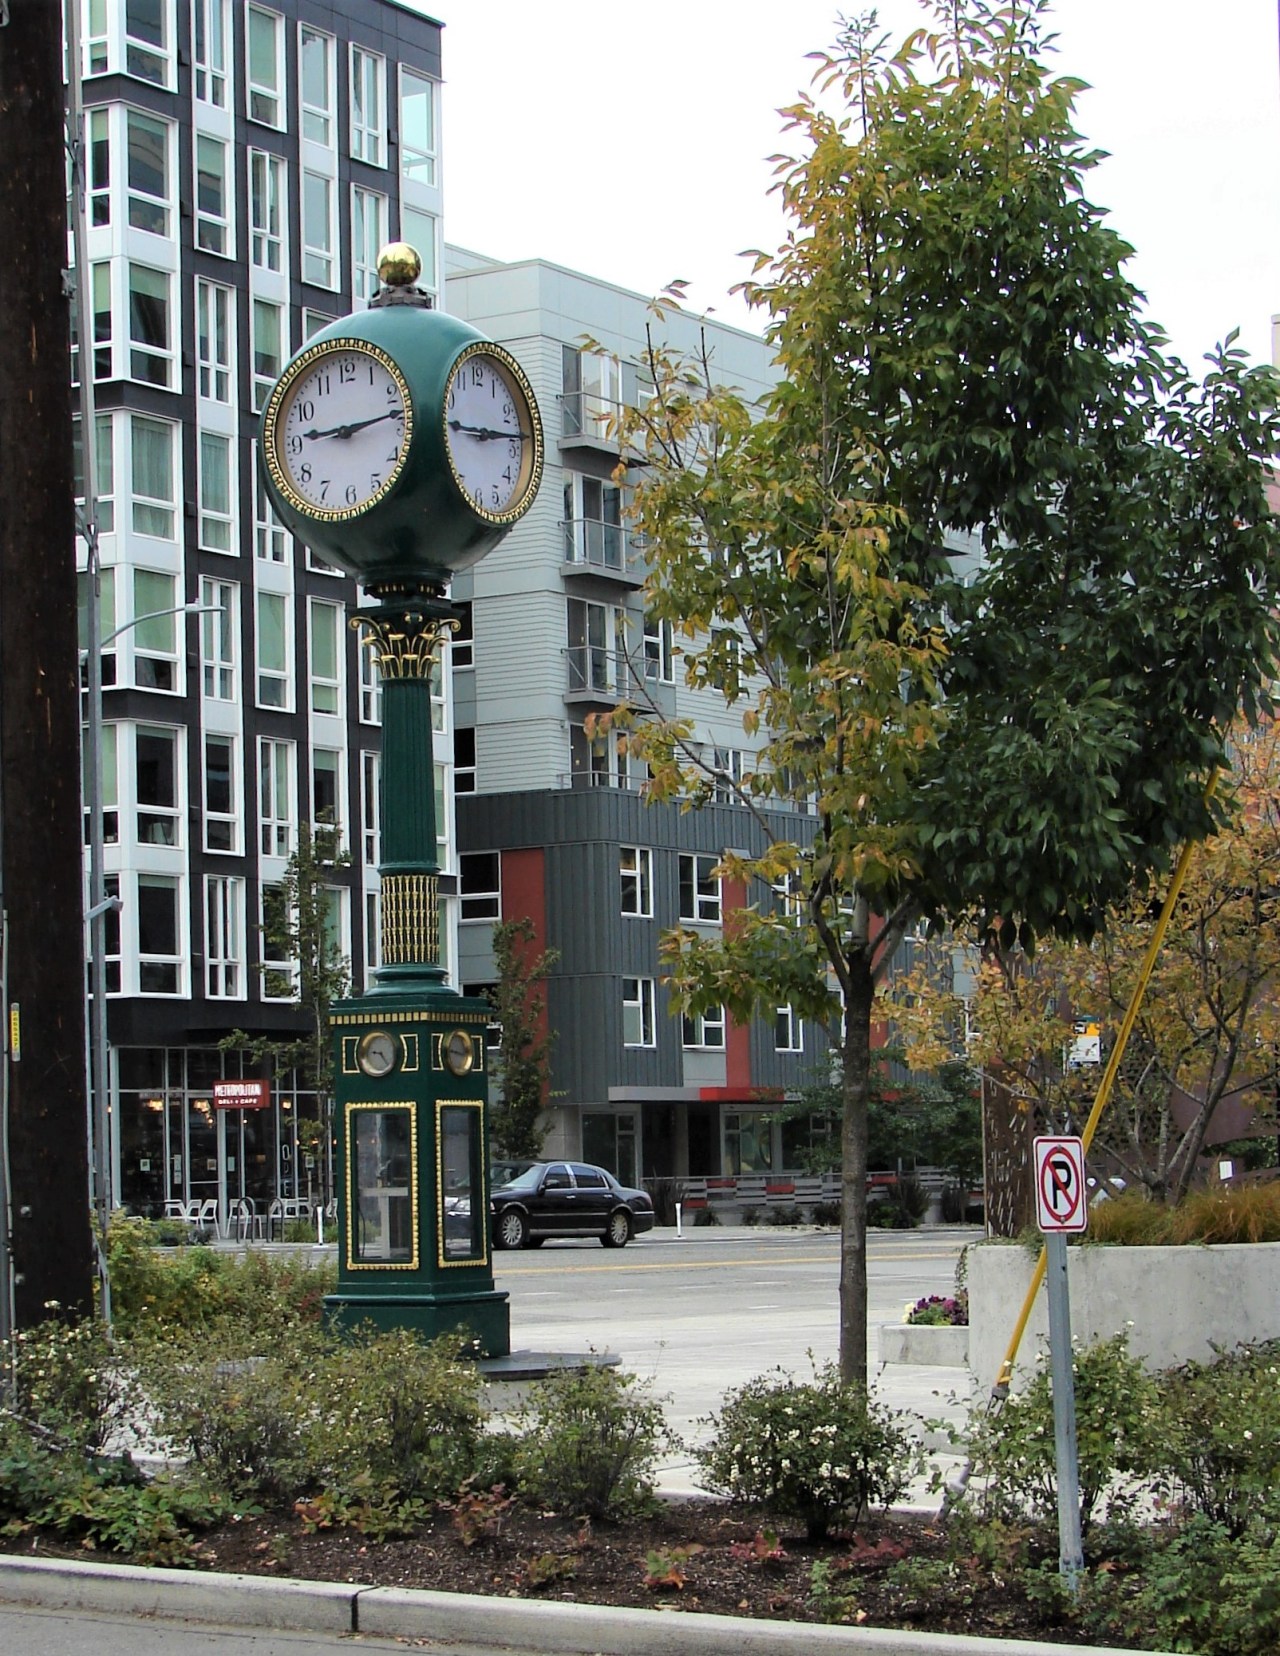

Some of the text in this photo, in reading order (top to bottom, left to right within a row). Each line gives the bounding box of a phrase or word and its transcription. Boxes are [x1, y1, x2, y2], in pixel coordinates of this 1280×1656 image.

[340, 362, 356, 384] 12
[369, 366, 374, 386] 1
[472, 366, 483, 387] 12
[318, 375, 330, 396] 11
[386, 383, 398, 404] 2
[299, 400, 315, 422] 10
[503, 404, 511, 424] 2
[291, 435, 303, 455] 9
[508, 439, 516, 459] 3
[301, 463, 312, 483] 8
[370, 473, 381, 493] 5
[502, 466, 511, 485] 4
[320, 480, 331, 500] 7
[345, 485, 357, 505] 6
[491, 485, 499, 505] 5
[215, 1084, 261, 1096] METROPOLITAN
[1051, 1161, 1072, 1209] P
